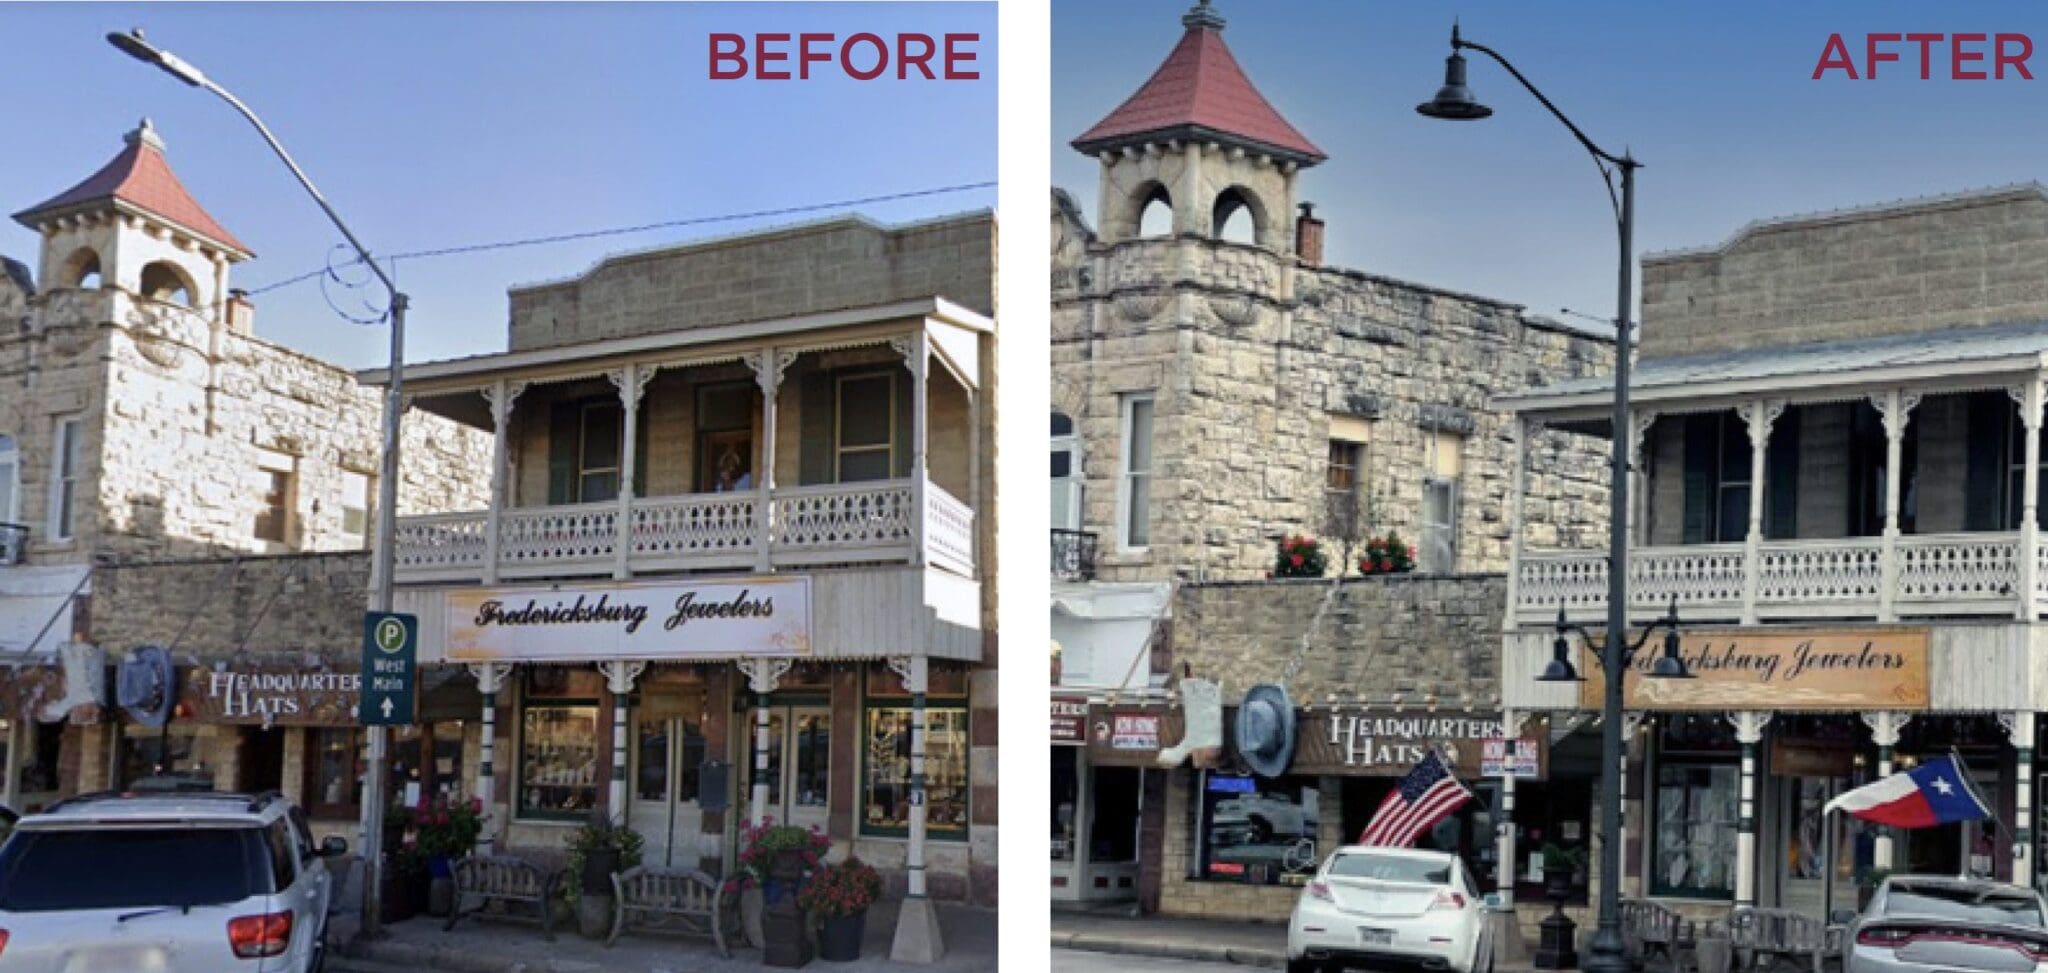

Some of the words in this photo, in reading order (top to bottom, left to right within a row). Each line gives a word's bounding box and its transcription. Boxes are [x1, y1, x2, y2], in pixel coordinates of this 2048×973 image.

[475, 593, 648, 634] Fredericksburg
[664, 589, 774, 630] Jewelers
[373, 658, 406, 673] West
[1783, 640, 1905, 681] Jewelers
[373, 675, 404, 690] Main
[223, 690, 300, 716] HATS
[1344, 736, 1424, 766] HATS
